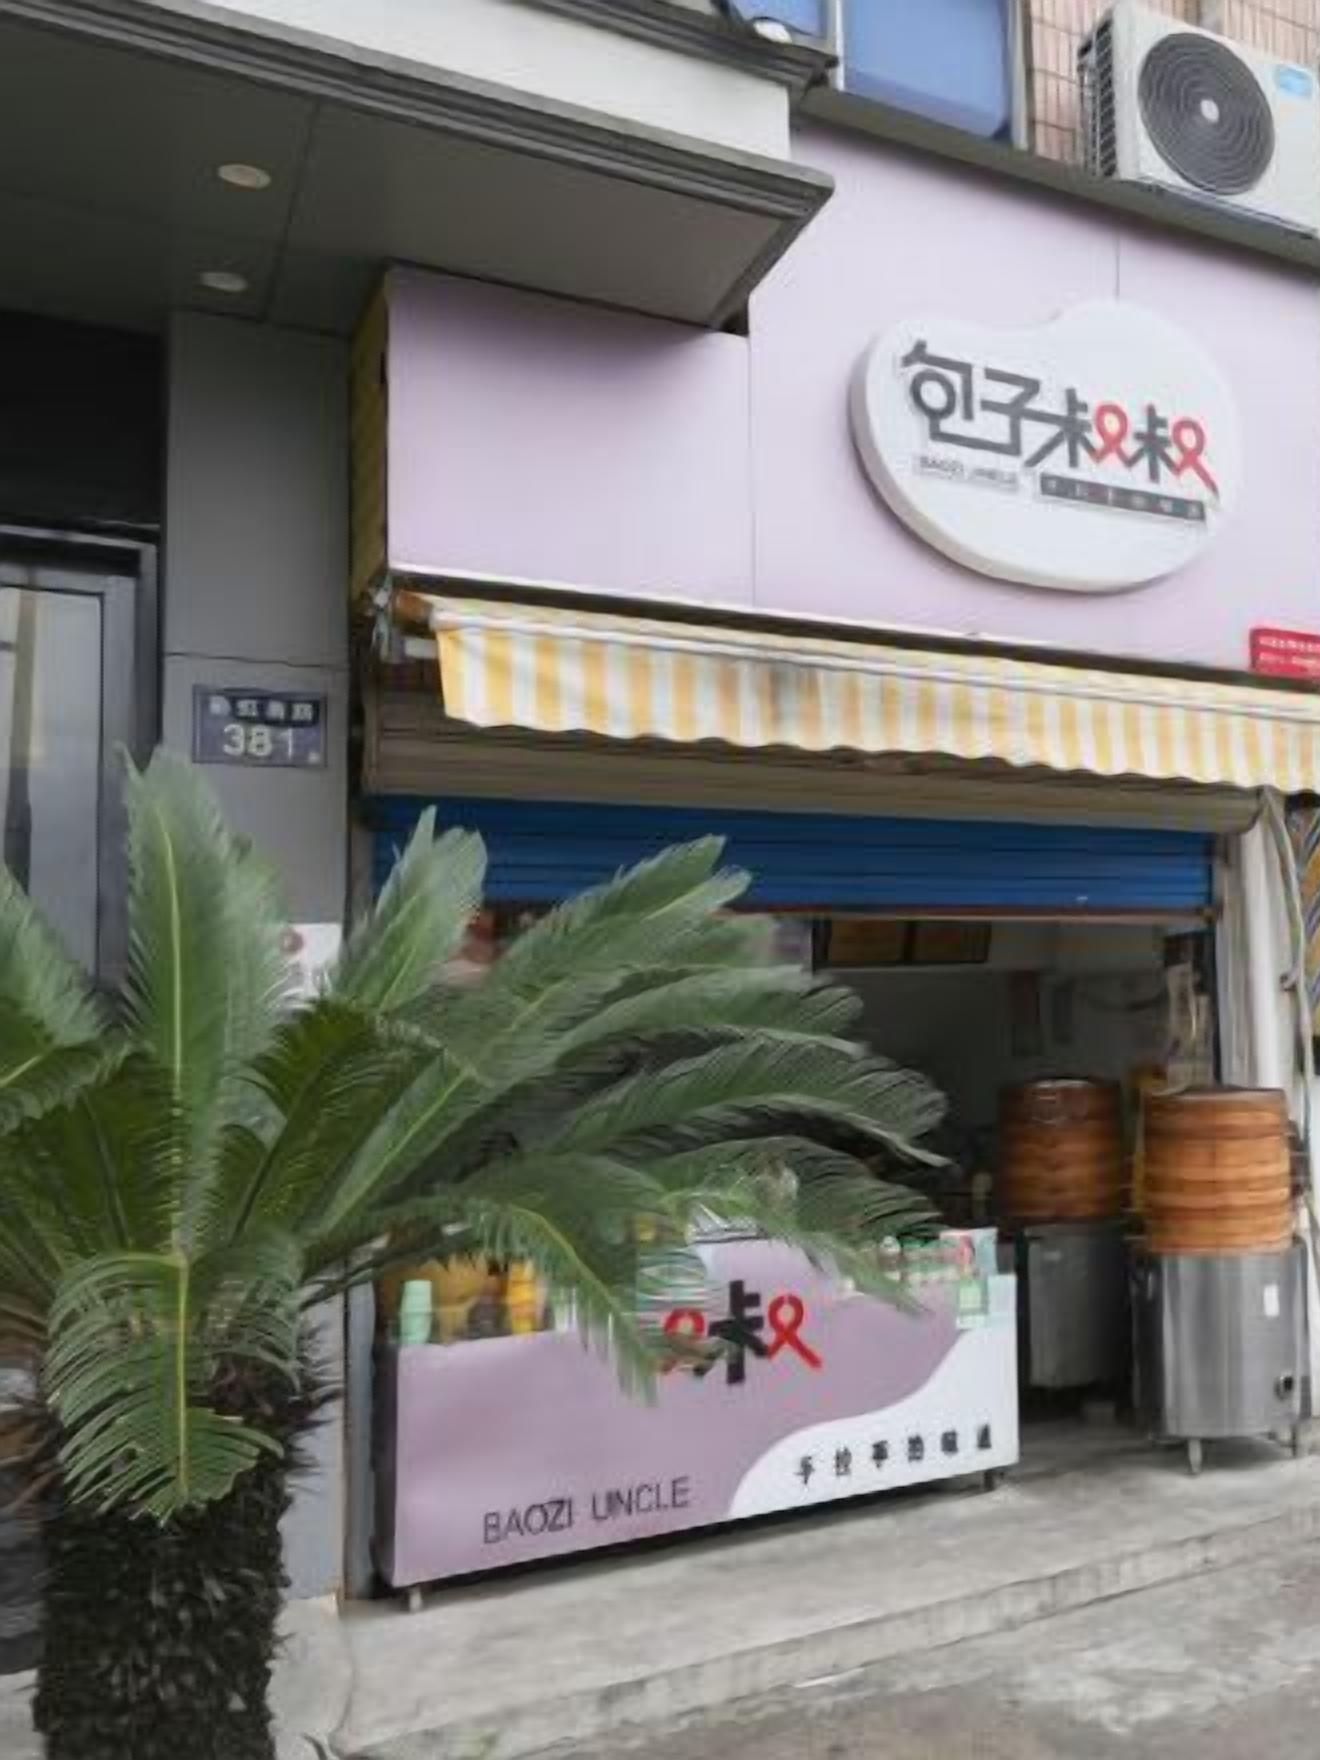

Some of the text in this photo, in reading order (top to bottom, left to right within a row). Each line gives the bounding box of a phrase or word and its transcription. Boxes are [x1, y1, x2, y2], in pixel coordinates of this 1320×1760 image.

[900, 339, 1221, 503] 包子叔叔
[222, 723, 293, 759] 381
[483, 1476, 691, 1544] BAOZI UNCLE
